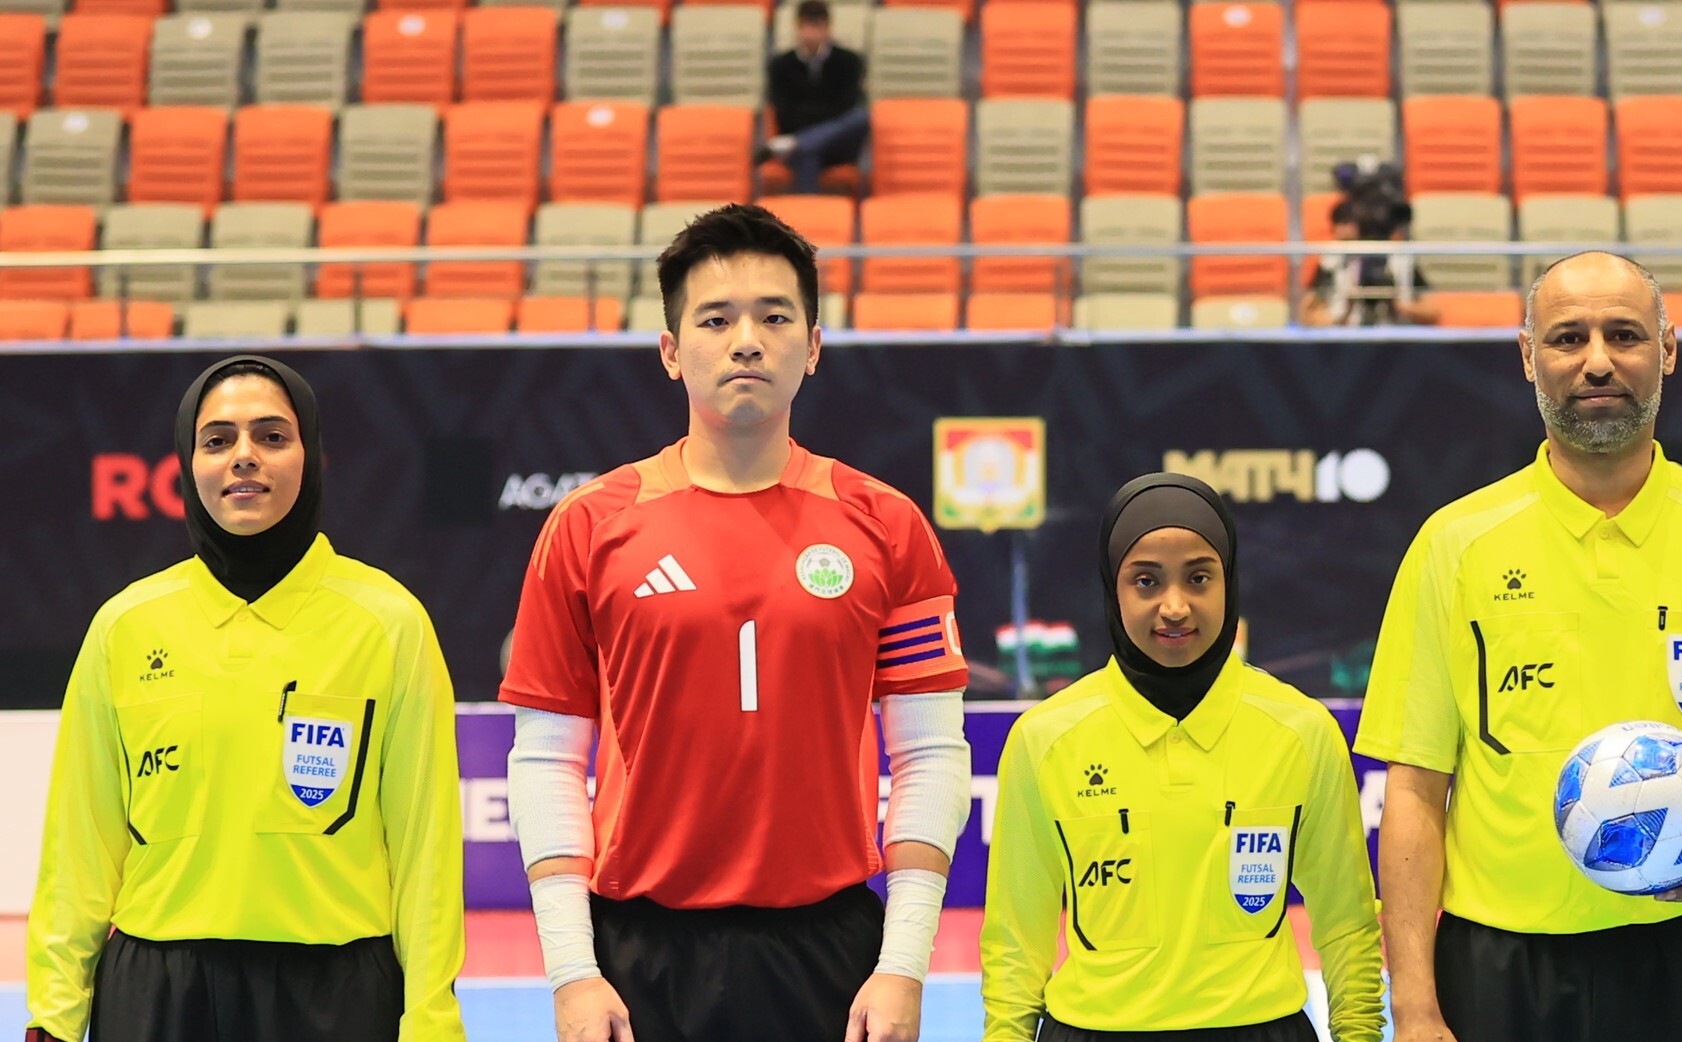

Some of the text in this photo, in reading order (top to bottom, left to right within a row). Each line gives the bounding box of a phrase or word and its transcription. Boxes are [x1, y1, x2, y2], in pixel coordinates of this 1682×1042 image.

[1494, 591, 1535, 601] KELME
[738, 620, 757, 713] 1
[139, 670, 175, 682] KELME
[1498, 662, 1555, 693] AFC
[291, 722, 345, 748] FIFA
[137, 745, 180, 778] AFC
[296, 754, 335, 767] FUTSAL
[293, 764, 336, 778] REFEREE
[299, 788, 324, 800] 2025
[1077, 787, 1117, 798] KELME
[1235, 832, 1282, 853] FIFA
[1078, 858, 1132, 887] AFC
[1241, 863, 1275, 873] FUTSAL
[1237, 874, 1276, 884] REFEREE
[1242, 896, 1266, 907] 2025
